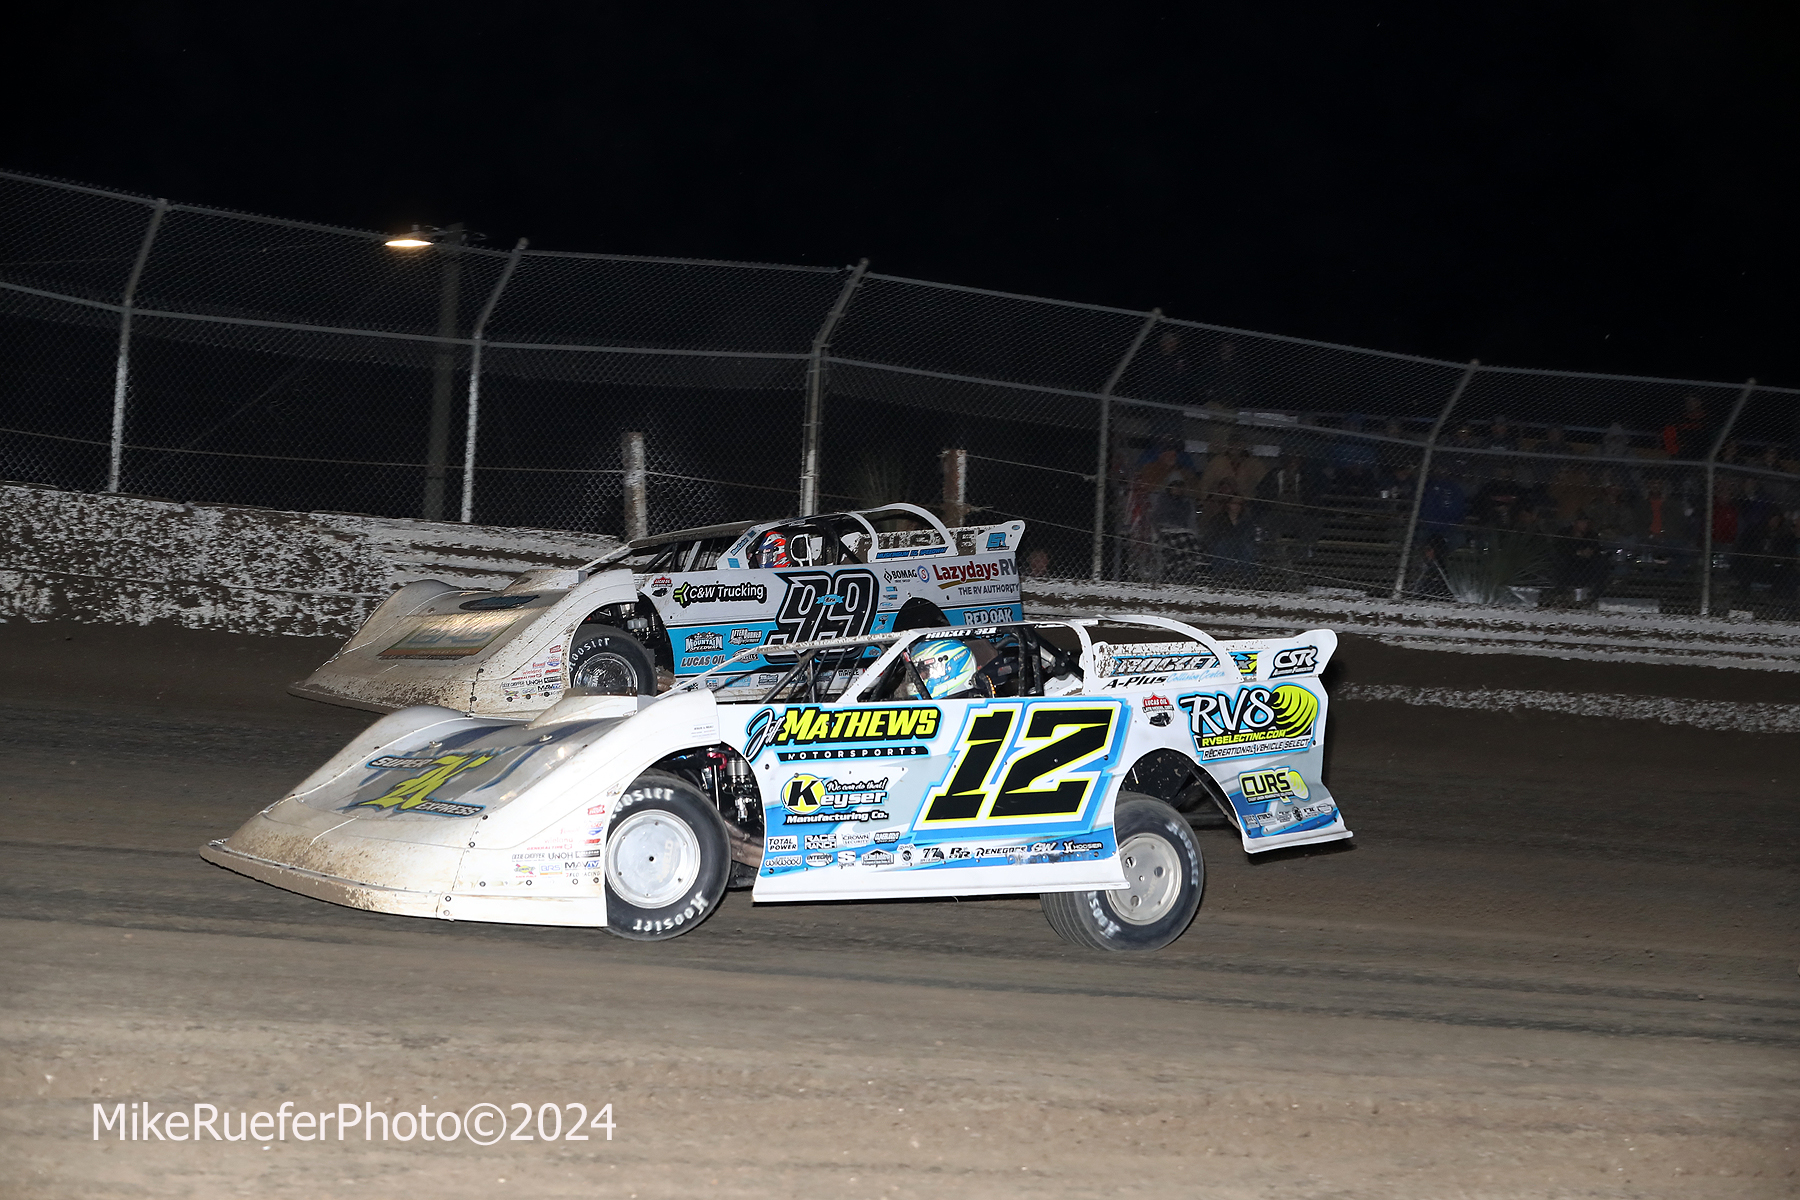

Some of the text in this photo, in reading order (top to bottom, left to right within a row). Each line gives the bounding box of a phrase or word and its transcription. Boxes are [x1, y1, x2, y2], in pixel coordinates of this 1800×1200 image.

[892, 569, 917, 579] BOMAG
[932, 558, 1017, 582] Lazydays RV
[690, 584, 764, 599] C&W Trucking
[958, 583, 1019, 596] THE RV AUTHORITY
[764, 569, 879, 664] 99
[964, 608, 1014, 625] RED OAK
[685, 635, 723, 651] MOUNTAIN
[681, 654, 726, 667] LUCAS OIL
[1274, 648, 1316, 668] CSR
[1102, 675, 1168, 690] A-Plus
[1167, 672, 1200, 683] Collision
[1180, 689, 1275, 735] RV8
[745, 709, 938, 760] Jeff MATHEWS
[1202, 729, 1286, 746] RVSELECTINC.COM
[788, 747, 917, 760] MOTORSPORTS
[1204, 740, 1310, 758] RECREATIONAL VEHICLE SELECT
[372, 757, 433, 768] SUPER
[922, 707, 1114, 823] 12
[827, 780, 841, 791] We
[788, 781, 887, 808] Keyser
[415, 801, 481, 815] EXPRESS
[787, 811, 887, 823] Manufacturing Co.
[769, 837, 792, 845] TOTAL
[548, 852, 573, 860] UNOH
[633, 891, 709, 934] Hoosier
